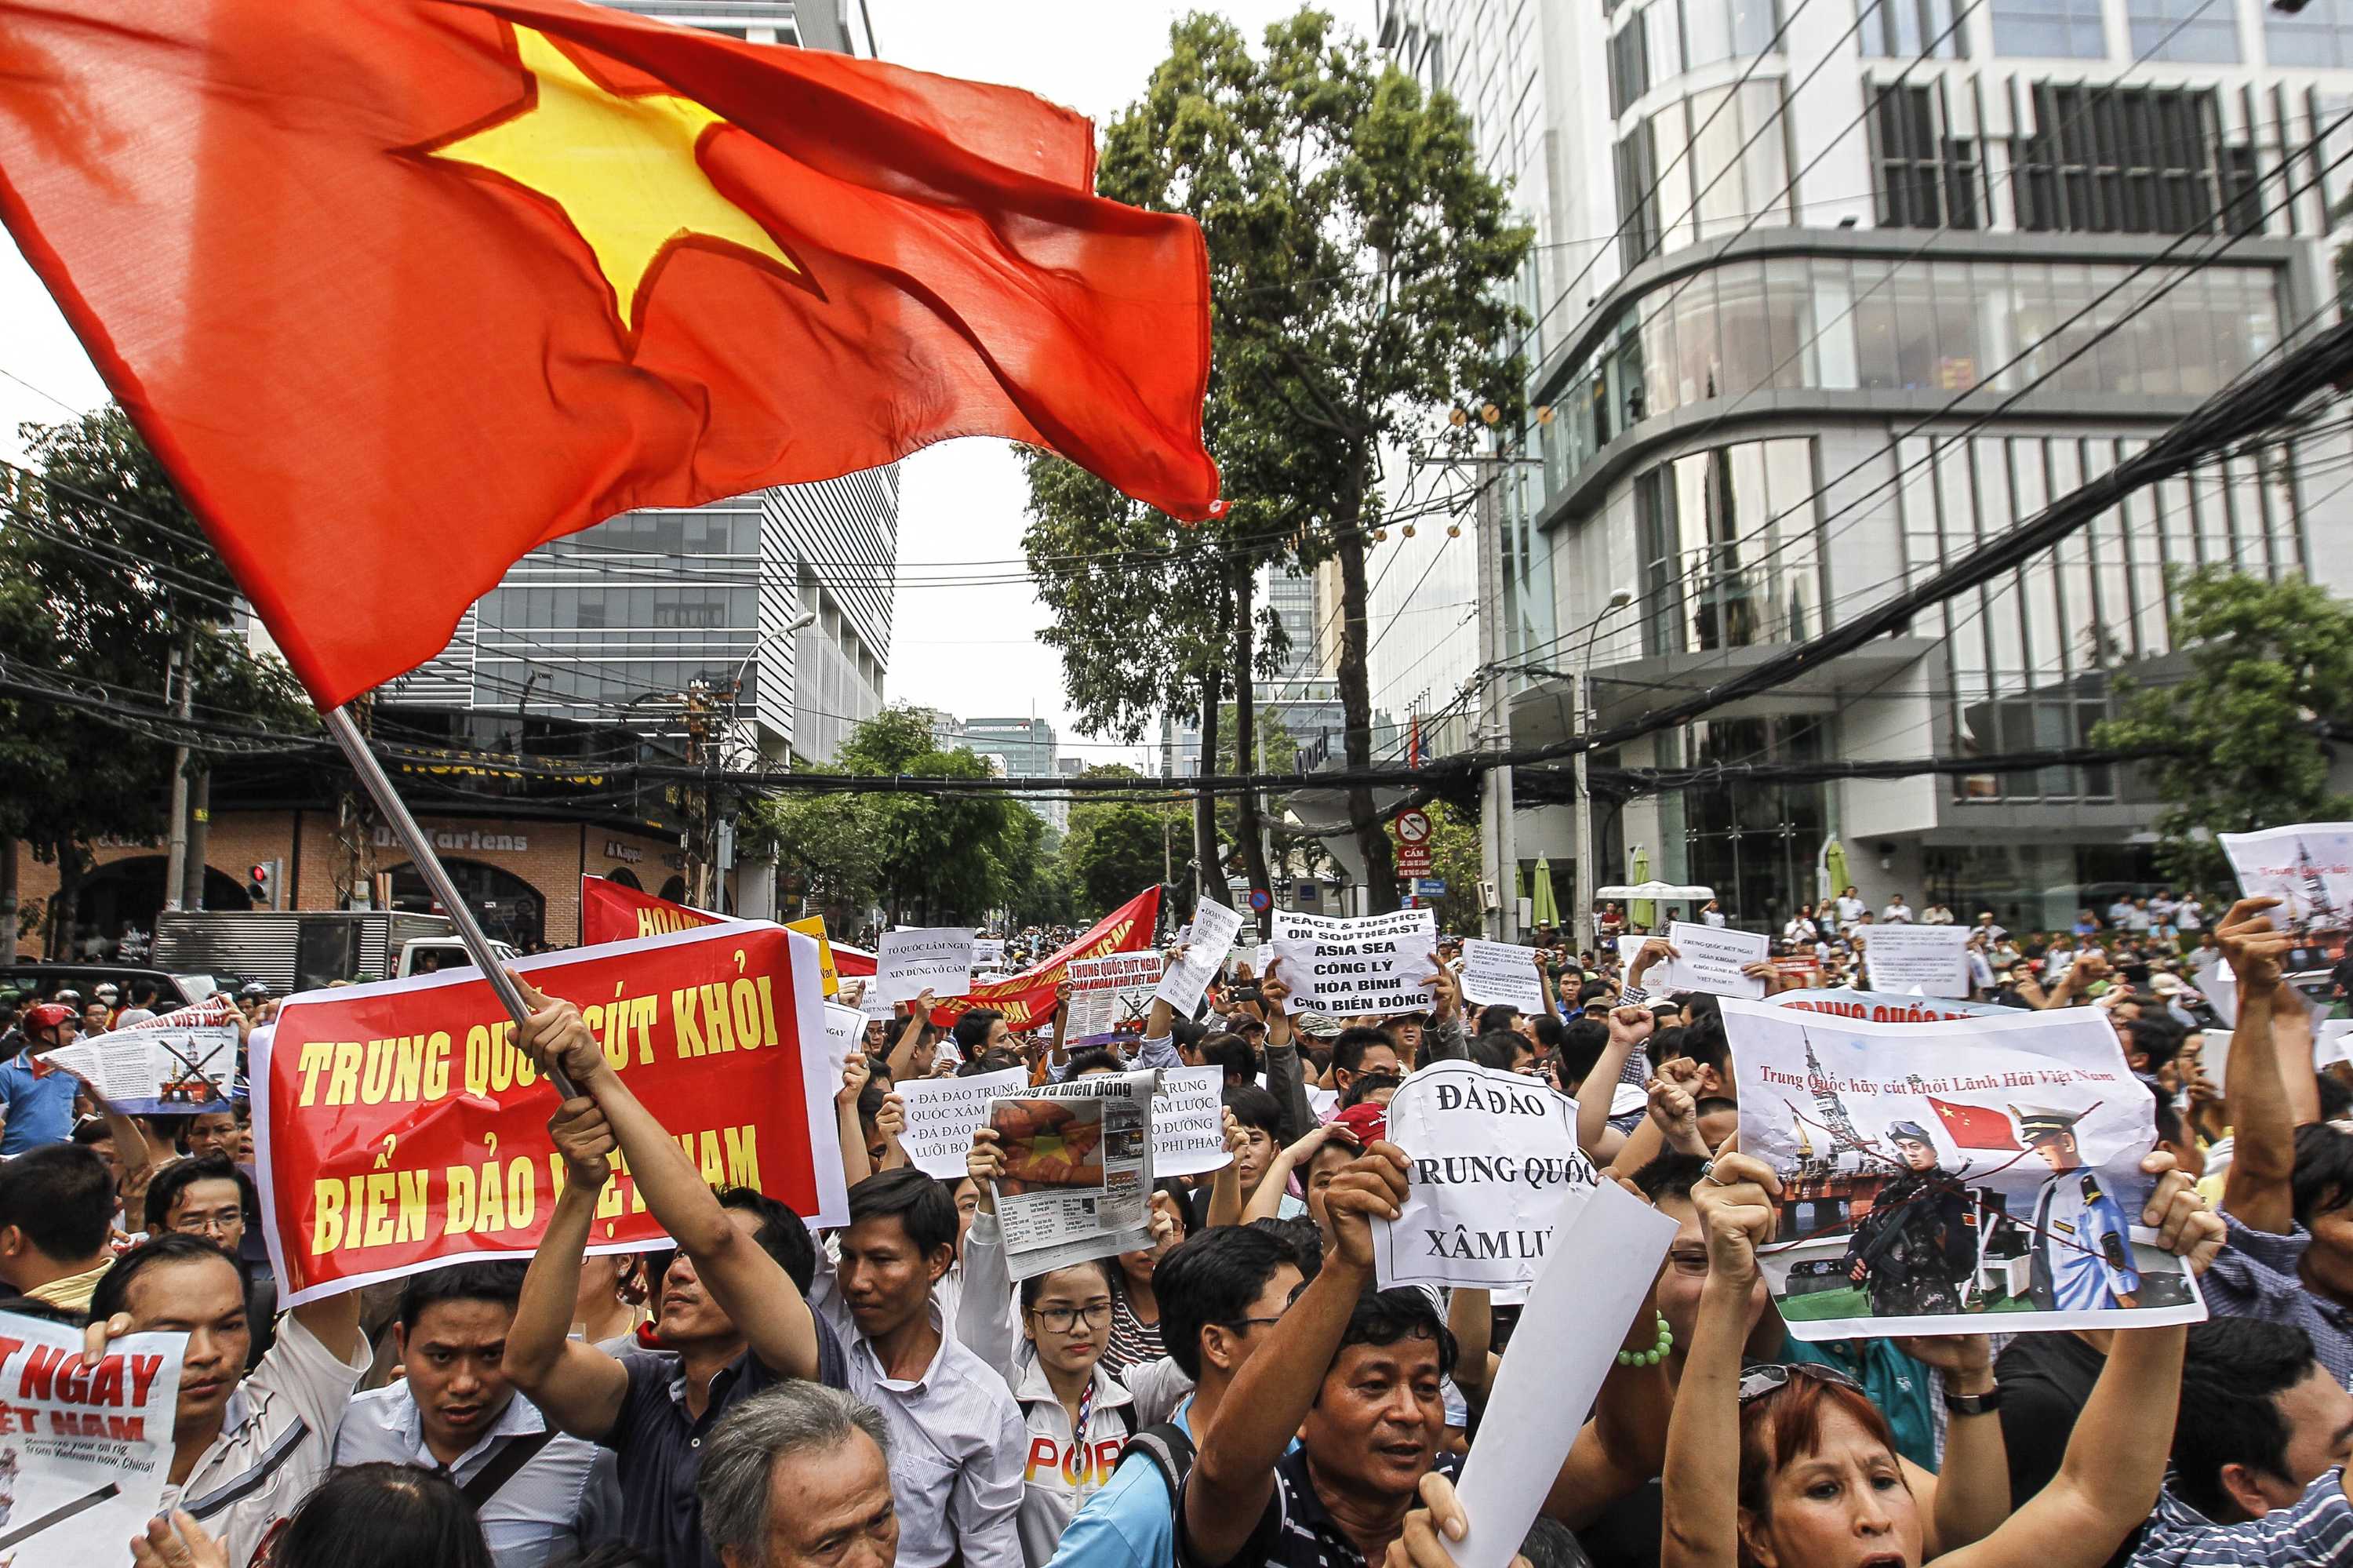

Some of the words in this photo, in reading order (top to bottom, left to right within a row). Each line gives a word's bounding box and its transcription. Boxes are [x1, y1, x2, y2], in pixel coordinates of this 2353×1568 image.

[1279, 915, 1336, 930] PEACE
[1358, 912, 1427, 928] JUSTICE
[1288, 930, 1312, 940] ON
[1318, 924, 1420, 941] SOUTHEAST
[1315, 945, 1357, 956] ASIA
[1362, 941, 1396, 954] SEA
[889, 970, 904, 978] XIN
[1071, 962, 1099, 979] TRUNG
[1100, 957, 1123, 977] QUỐC
[1141, 958, 1161, 972] NGAY
[1314, 962, 1366, 975] CÔNG
[1373, 959, 1393, 972] LÝ
[1089, 977, 1114, 990] KHOAN
[1146, 972, 1161, 984] NAM
[1358, 978, 1401, 991] BÌNH
[1293, 997, 1326, 1011] CHO
[1379, 994, 1428, 1008] ĐÔNG
[298, 1031, 450, 1107] TRUNG
[673, 949, 779, 1059] KHỎI
[1095, 1081, 1132, 1098] Đông
[1760, 1065, 1804, 1091] Trung
[1807, 1071, 1846, 1093] Quốc
[1849, 1078, 1878, 1097] hãy
[1884, 1079, 1907, 1094] cút
[1953, 1075, 1999, 1092] Lãnh
[2038, 1068, 2071, 1086] Việt
[2073, 1068, 2116, 1082] Nam
[918, 1090, 938, 1104] ĐẢ
[942, 1088, 972, 1102] ĐẢO
[975, 1082, 1018, 1098] TRUNG
[1435, 1076, 1486, 1111] ĐẢ
[1486, 1086, 1546, 1117] ĐẢO
[954, 1103, 985, 1118] XÂM
[1176, 1097, 1217, 1111] LƯỢC.
[918, 1125, 938, 1140] ĐẢ
[941, 1122, 972, 1137] ĐẢO
[1164, 1117, 1213, 1133] ĐƯỜNG
[1162, 1140, 1184, 1152] PHI
[312, 1133, 428, 1256] BIỂN
[444, 1131, 536, 1235] ĐẢO
[1424, 1224, 1512, 1261] XÂM
[19, 1344, 164, 1407] NGAY
[51, 1410, 144, 1442] NAM
[72, 1442, 95, 1453] your
[25, 1445, 52, 1457] from
[54, 1449, 95, 1464] Vietnam
[122, 1457, 155, 1474] China!
